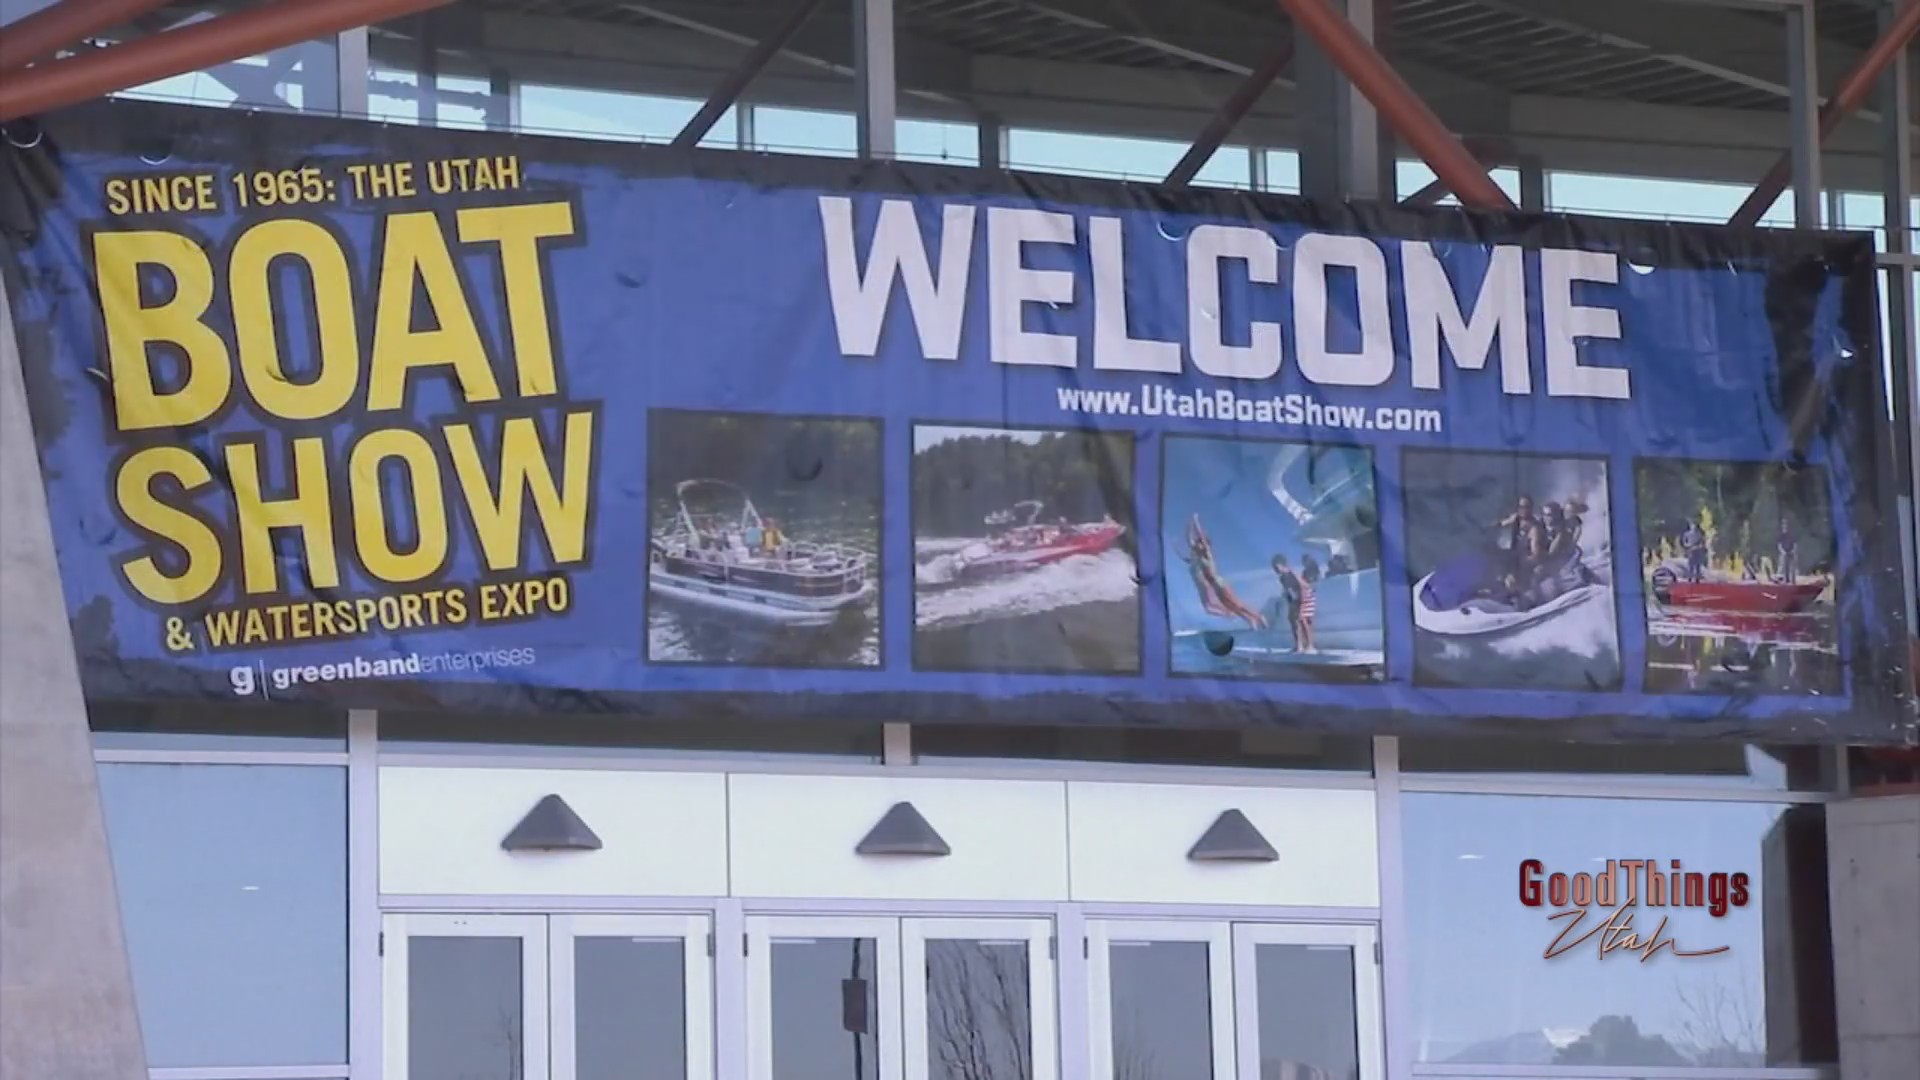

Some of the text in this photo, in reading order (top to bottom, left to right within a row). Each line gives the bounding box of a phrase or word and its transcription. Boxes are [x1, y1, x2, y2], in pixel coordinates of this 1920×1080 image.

[107, 156, 519, 215] SINCE 1965: THE UTAH
[93, 201, 575, 431] BOAT
[818, 196, 1632, 400] WELCOME
[1057, 383, 1442, 433] www.UtahBoatShow.com
[116, 412, 593, 605] SHOW
[165, 578, 569, 651] & WATERSPORTS EXPO
[230, 666, 254, 696] g
